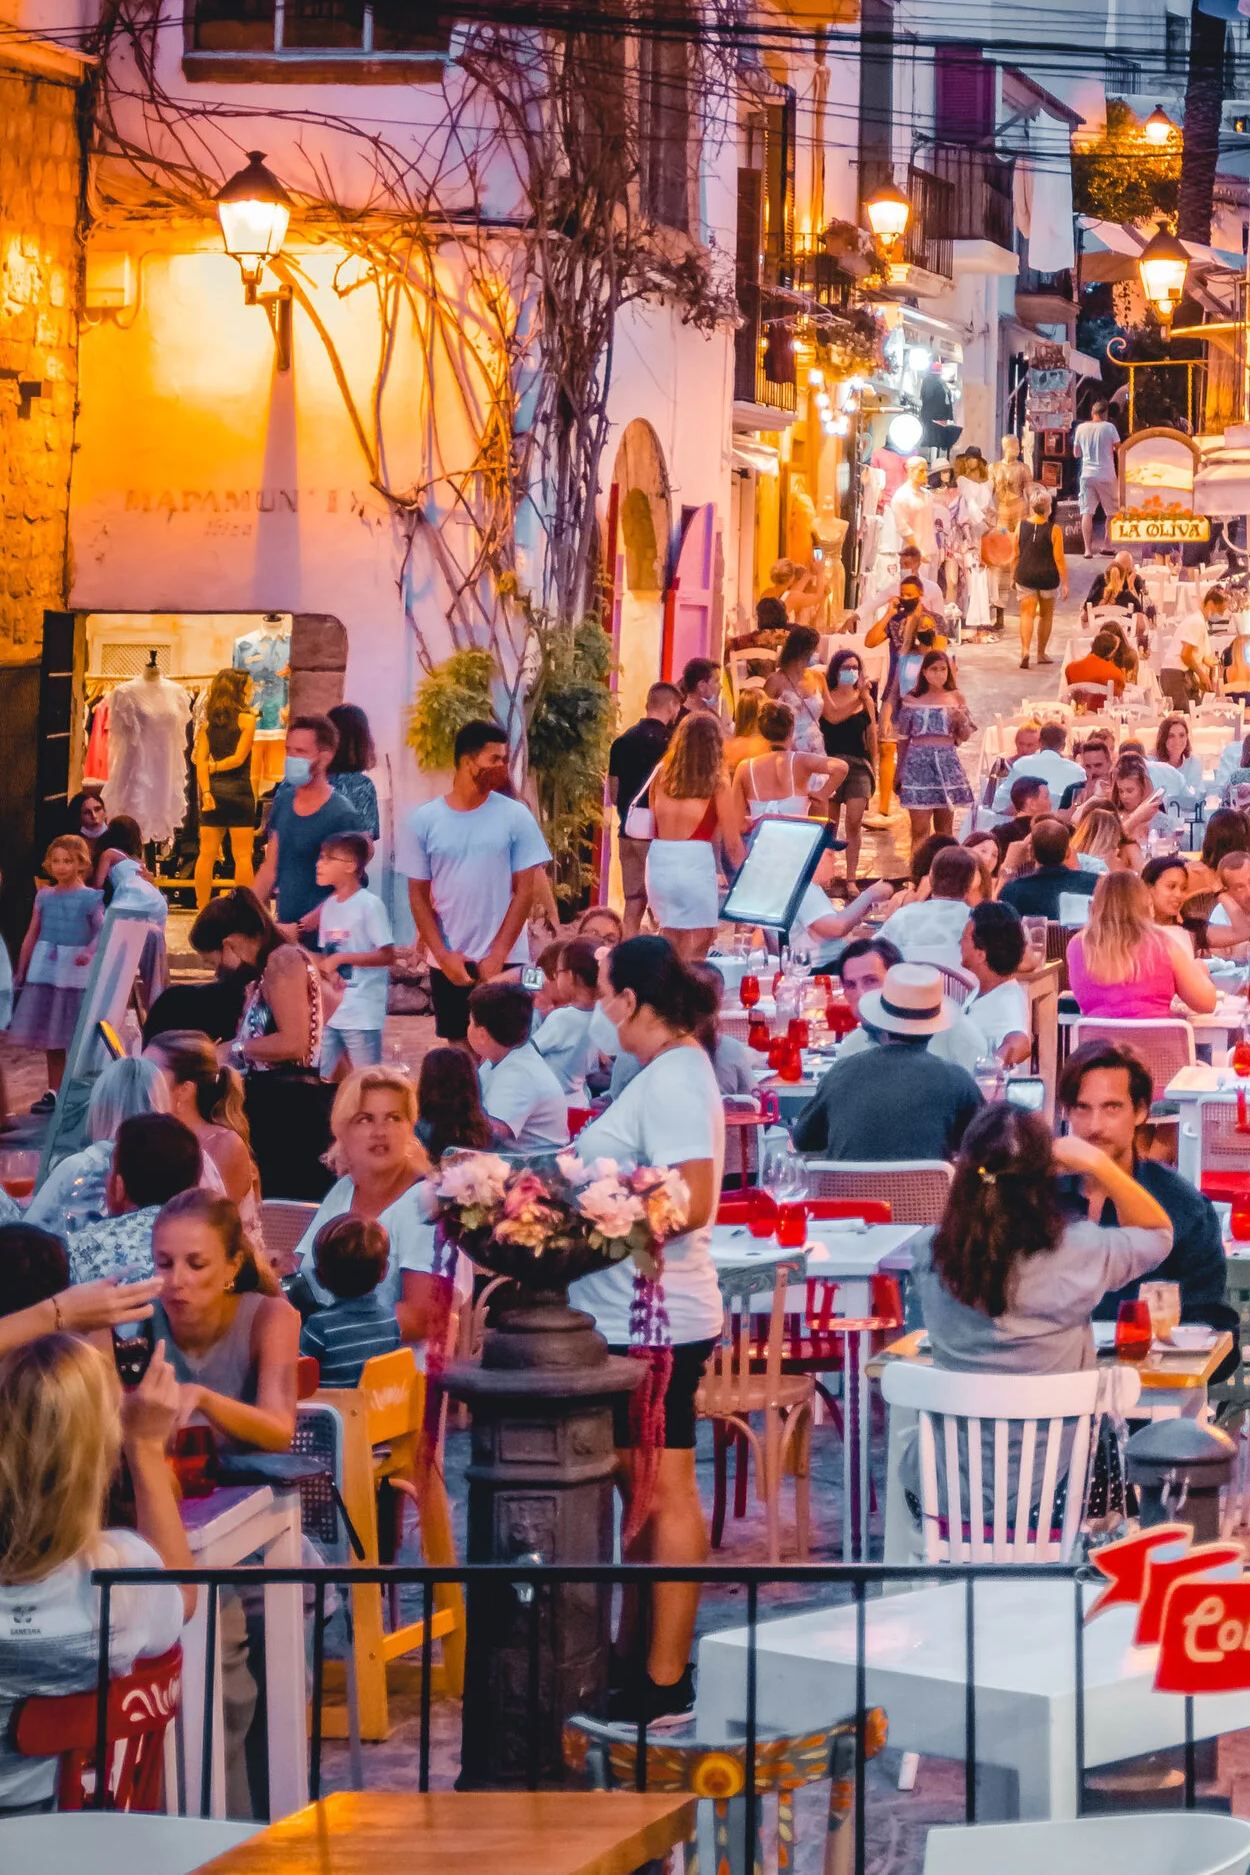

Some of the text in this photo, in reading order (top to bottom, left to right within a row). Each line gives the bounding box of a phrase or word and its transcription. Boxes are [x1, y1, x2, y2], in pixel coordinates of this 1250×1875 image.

[123, 488, 338, 513] MAPAMUNI
[1119, 523, 1201, 538] LA OLIVA
